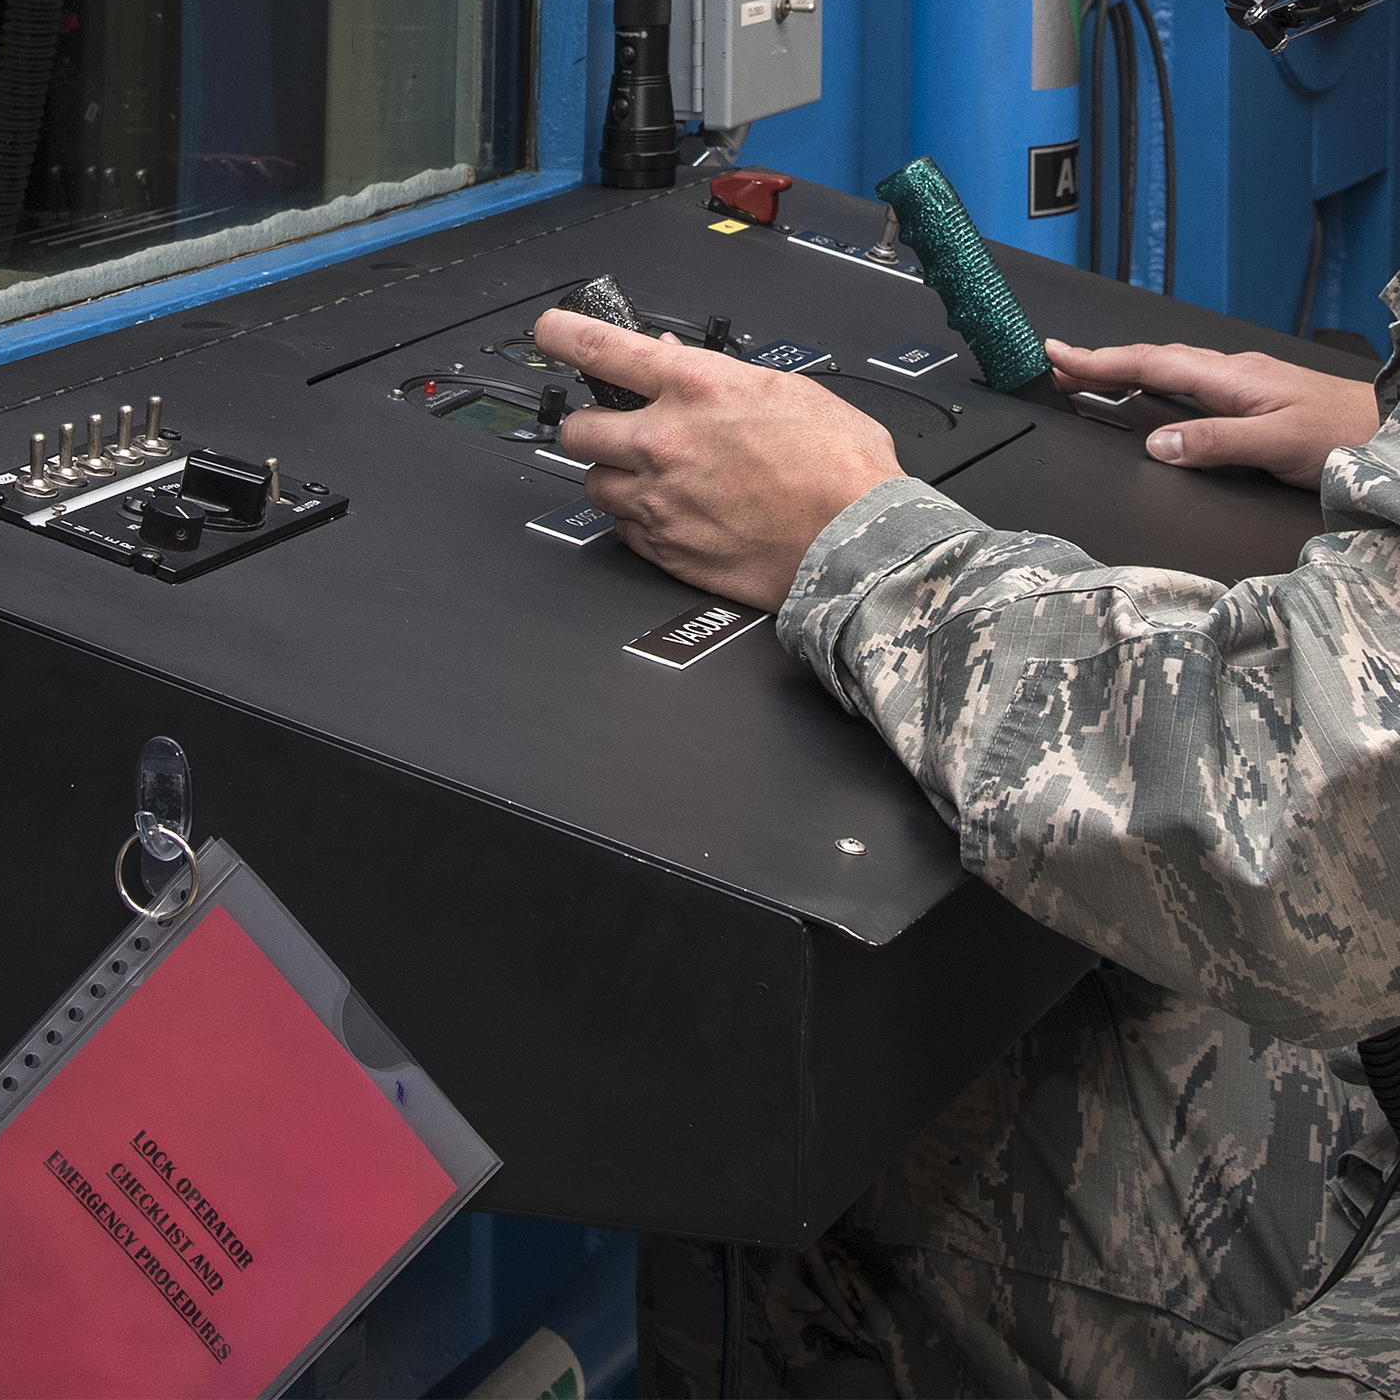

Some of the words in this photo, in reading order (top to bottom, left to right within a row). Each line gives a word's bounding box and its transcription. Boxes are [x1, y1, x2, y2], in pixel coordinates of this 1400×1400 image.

[60, 519, 136, 551] INTER
[661, 606, 742, 649] VACUUM
[46, 1149, 140, 1248] EMERGENCY
[134, 1245, 232, 1360] PROCEDURES
[110, 1162, 195, 1254] CHECKLIST
[188, 1253, 224, 1292] AND
[132, 1129, 178, 1181] LOCK
[176, 1177, 255, 1270] OPERATOR
